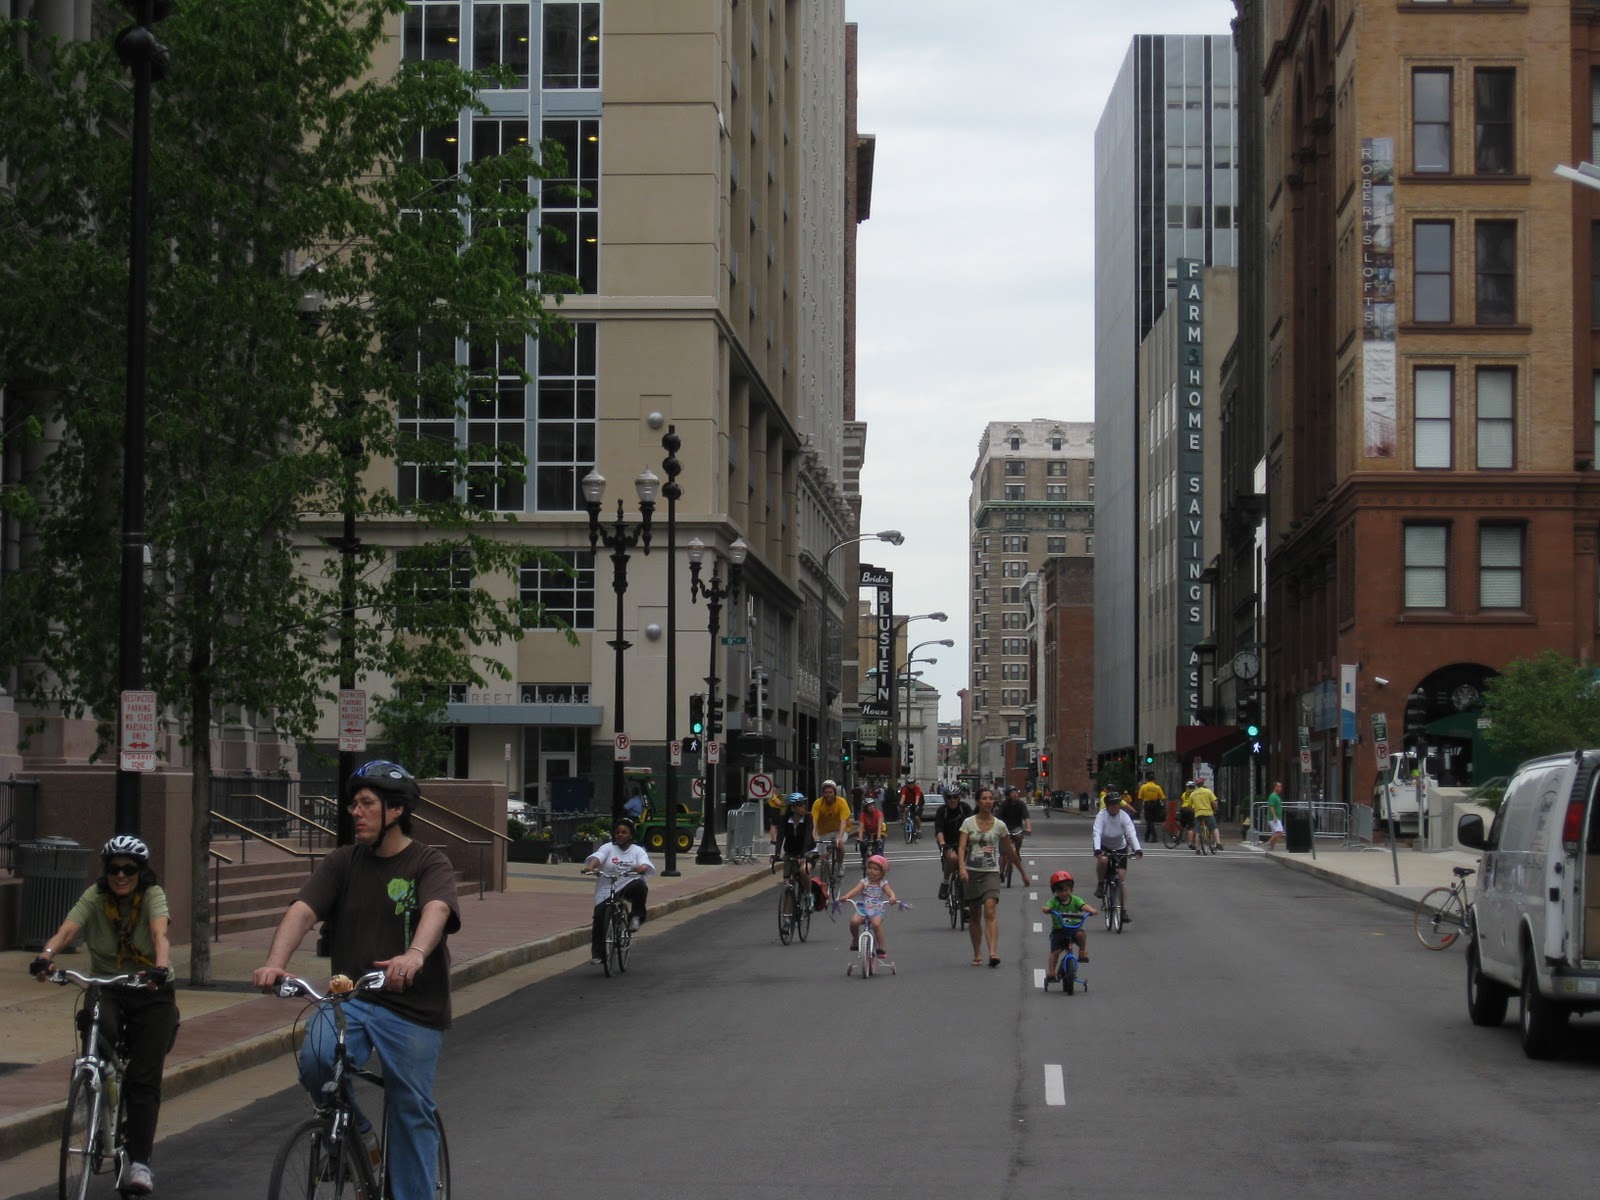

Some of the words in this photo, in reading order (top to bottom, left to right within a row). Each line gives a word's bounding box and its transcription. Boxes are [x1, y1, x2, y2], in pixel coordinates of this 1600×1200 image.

[1361, 148, 1373, 246] ROBERTS
[1363, 253, 1374, 322] LOFTS
[1188, 263, 1201, 343] FARM
[1189, 369, 1201, 450] HOME
[1189, 477, 1201, 623] SAVINGS
[861, 571, 889, 584] Bride's
[877, 590, 890, 701] BLUSTEIN
[124, 694, 154, 702] RESTRICTED
[450, 694, 512, 704] STREET
[523, 694, 589, 704] GARAGE
[128, 704, 151, 712] PARKING
[862, 704, 889, 716] House
[138, 714, 153, 722] STATE
[132, 732, 146, 740] ONLY
